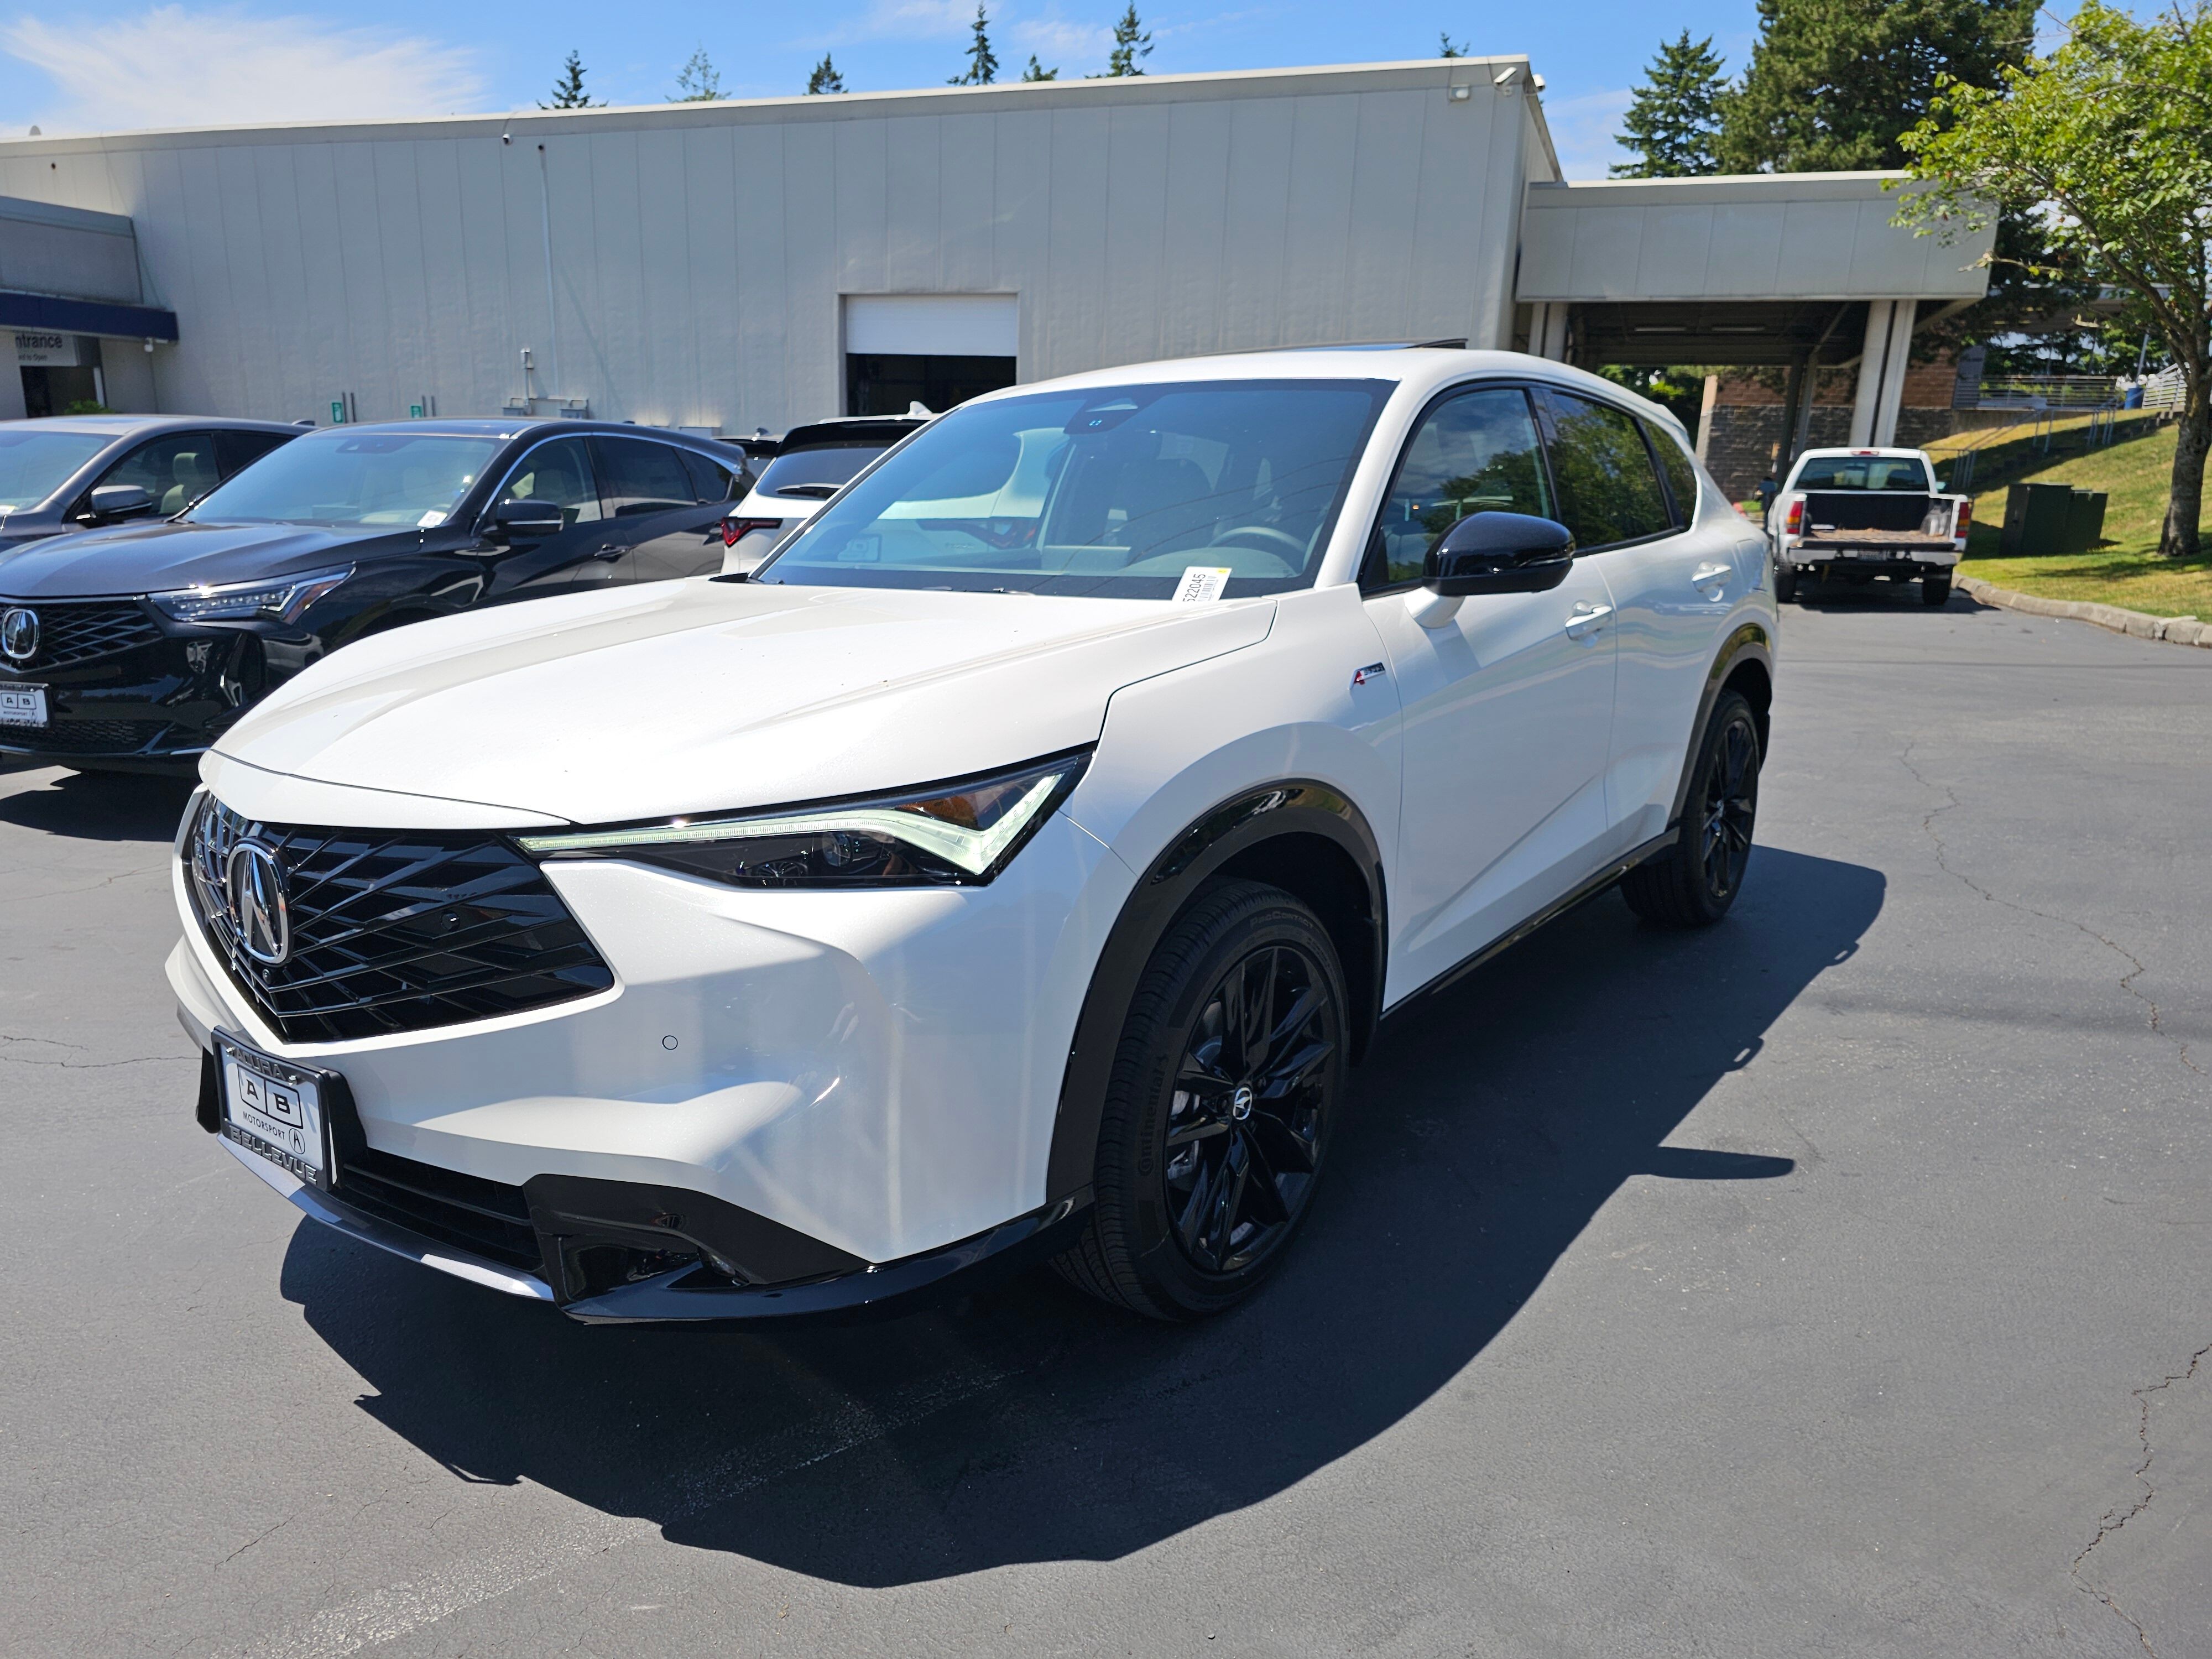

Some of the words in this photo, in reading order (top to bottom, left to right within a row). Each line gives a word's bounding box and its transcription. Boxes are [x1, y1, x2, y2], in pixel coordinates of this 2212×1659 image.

[235, 1048, 285, 1081] ACURA
[246, 1079, 259, 1100] A
[273, 1092, 290, 1114] B
[243, 1111, 285, 1140] MOTORSPORT
[230, 1125, 317, 1185] BELLEVUE
